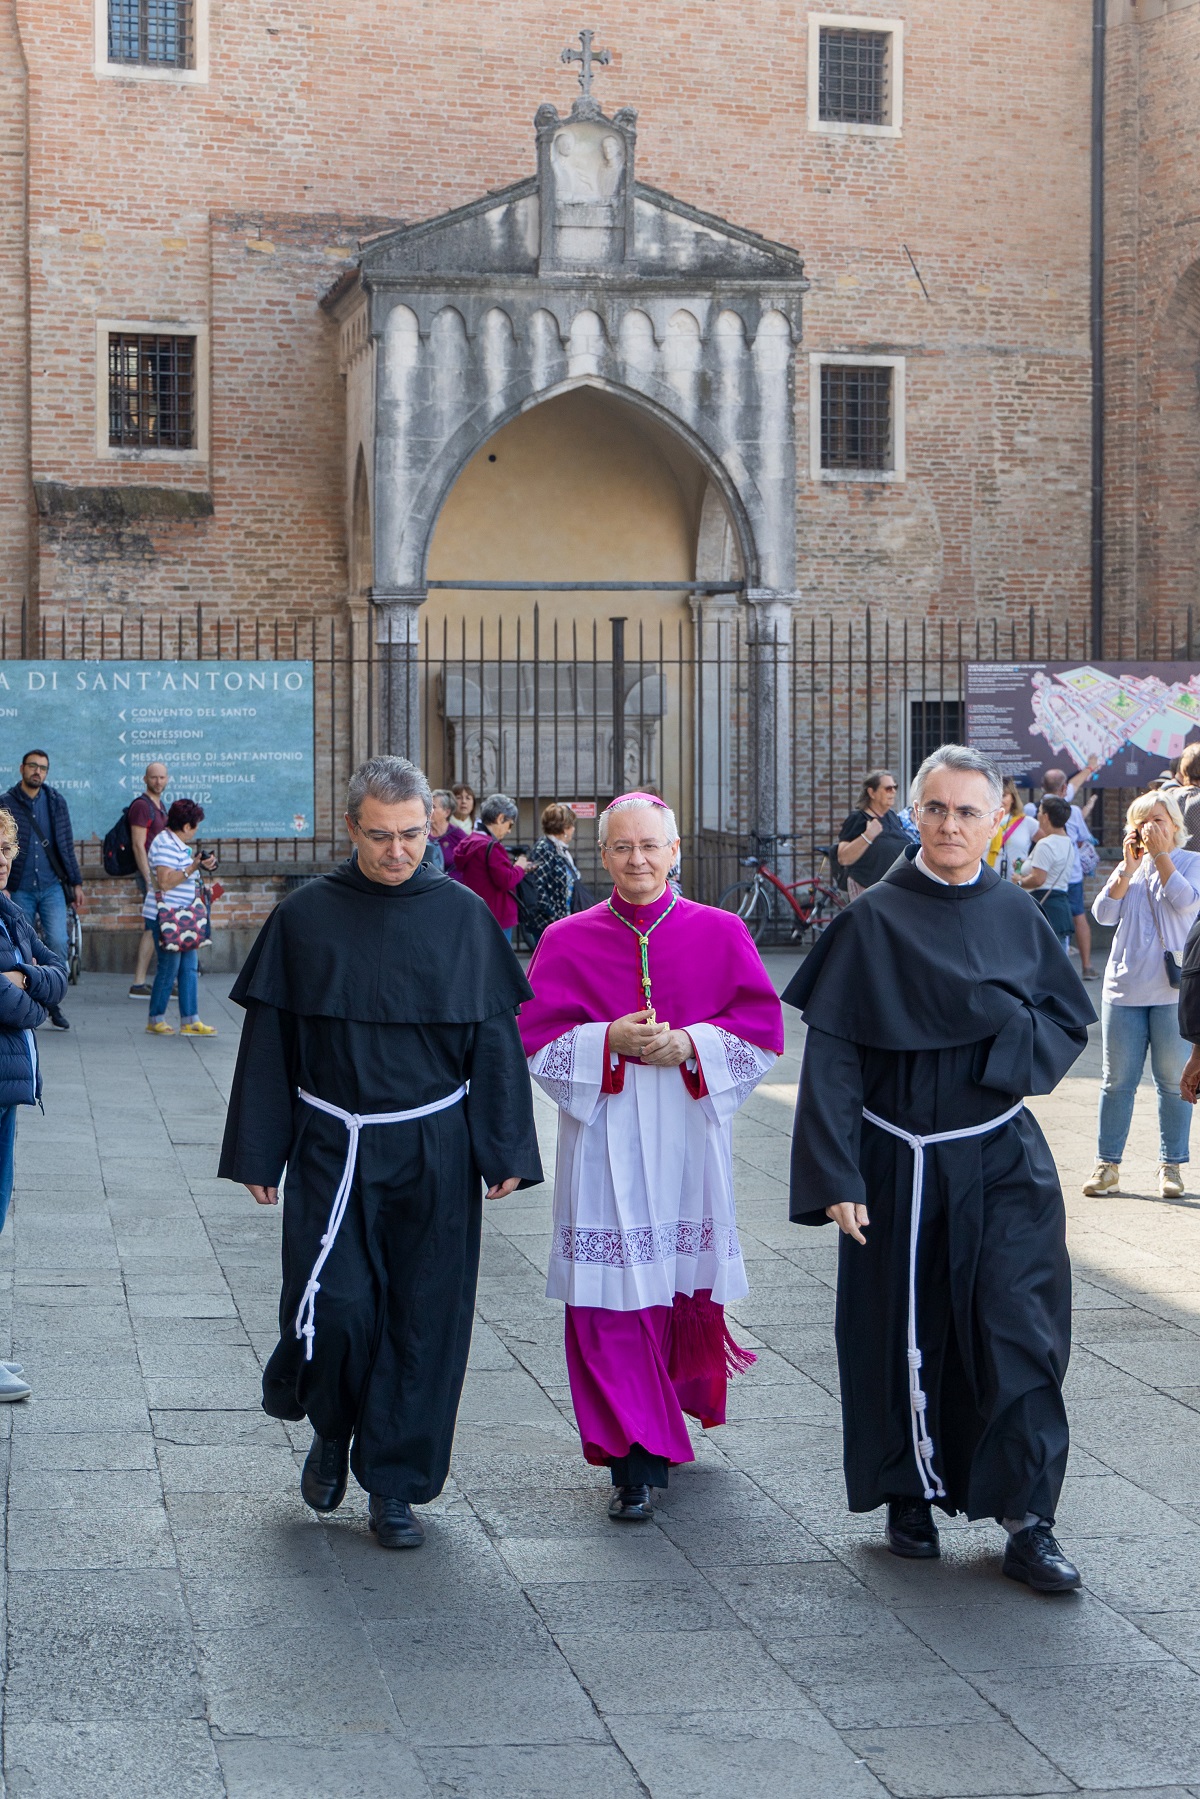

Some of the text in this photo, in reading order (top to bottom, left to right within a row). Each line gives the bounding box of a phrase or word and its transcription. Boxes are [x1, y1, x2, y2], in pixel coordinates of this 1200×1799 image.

[28, 672, 59, 690] DI
[76, 671, 303, 691] SANT'ANTONIO
[131, 708, 257, 717] CONVENTO DEL SANTO
[131, 730, 204, 739] CONFESSIONI
[131, 751, 303, 761] MESSAGGERO DI SANT'ANTONIO
[180, 774, 257, 783] MULTIMEDIALE
